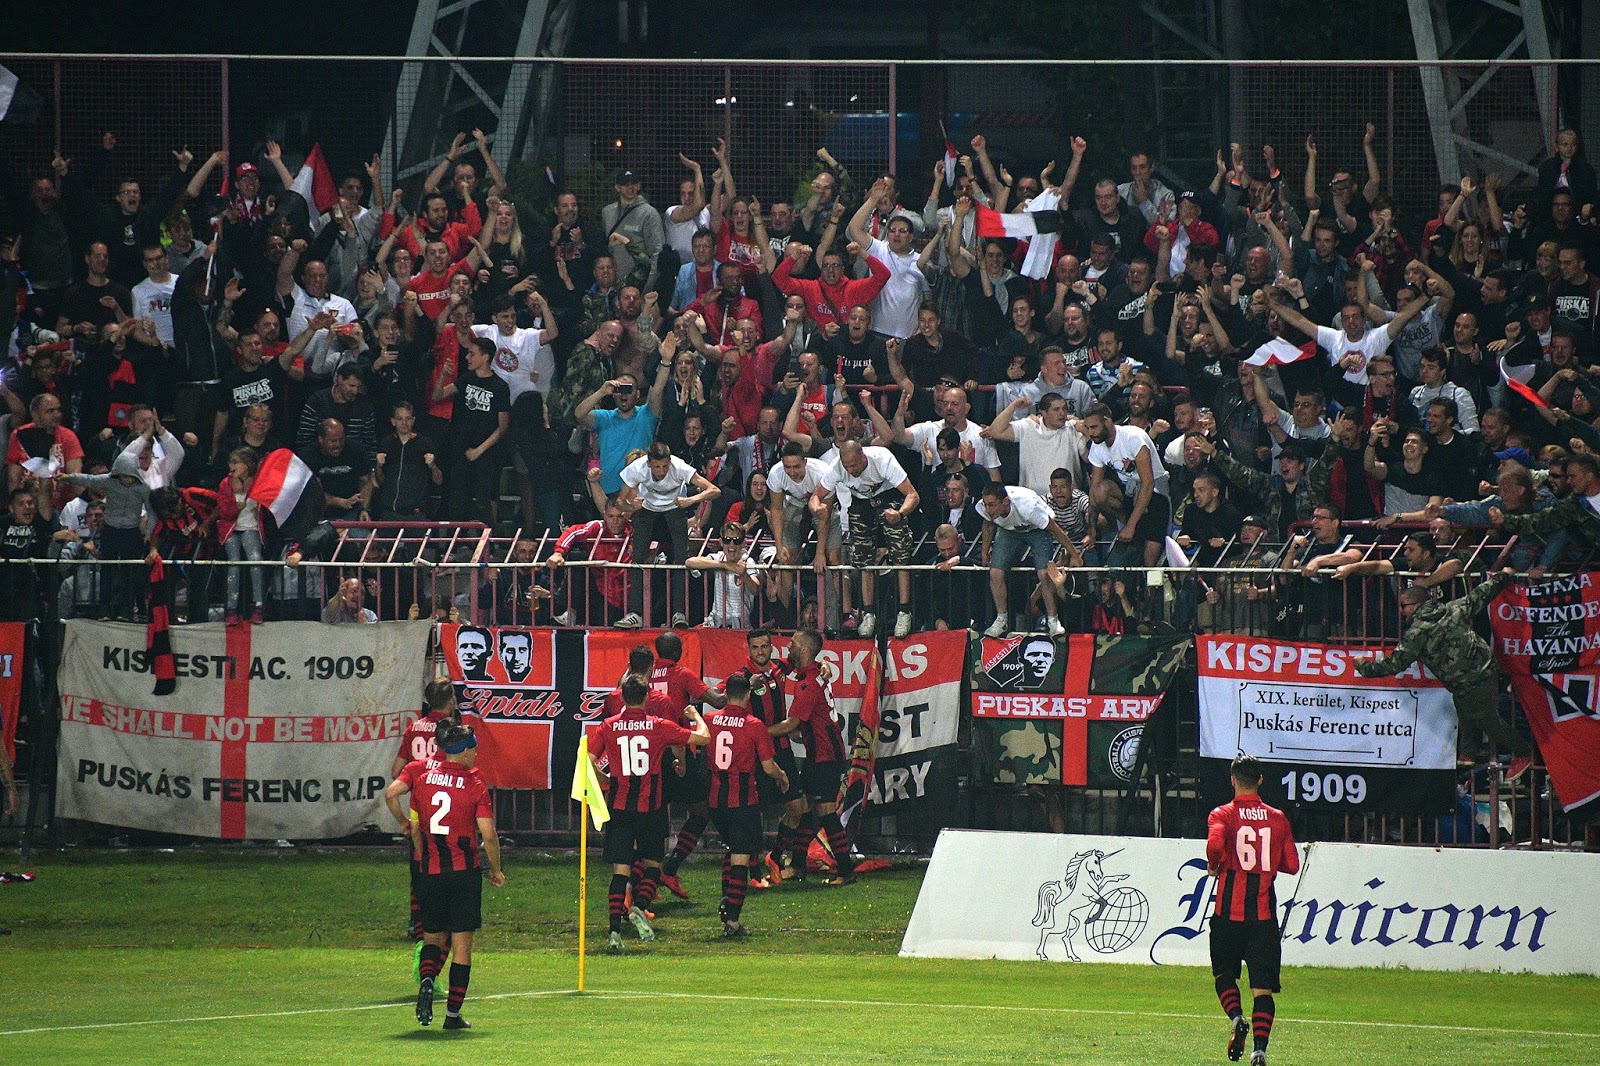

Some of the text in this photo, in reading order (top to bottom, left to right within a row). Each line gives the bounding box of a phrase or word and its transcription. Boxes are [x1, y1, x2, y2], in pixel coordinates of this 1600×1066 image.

[1498, 600, 1600, 623] OFFENDE
[103, 646, 374, 681] KISESTI AC. 1909
[985, 640, 1019, 671] KISPESTI AC
[1002, 663, 1021, 671] 1909
[460, 688, 565, 718] Lipták
[1100, 697, 1158, 719] ARM
[1255, 690, 1401, 713] XIX. kerület, Kispest
[101, 703, 194, 739] SHALL
[205, 715, 264, 742] NOT
[274, 717, 313, 741] BE
[712, 714, 745, 728] GAZDAG
[1243, 711, 1413, 737] Puskás Ferenc utca
[616, 735, 650, 776] 16
[715, 730, 734, 770] 6
[78, 759, 192, 799] PUSKÁS
[203, 778, 322, 804] FERENC
[455, 776, 466, 790] D.
[1281, 770, 1368, 804] 1909
[430, 791, 452, 835] 2
[1235, 825, 1271, 872] 61
